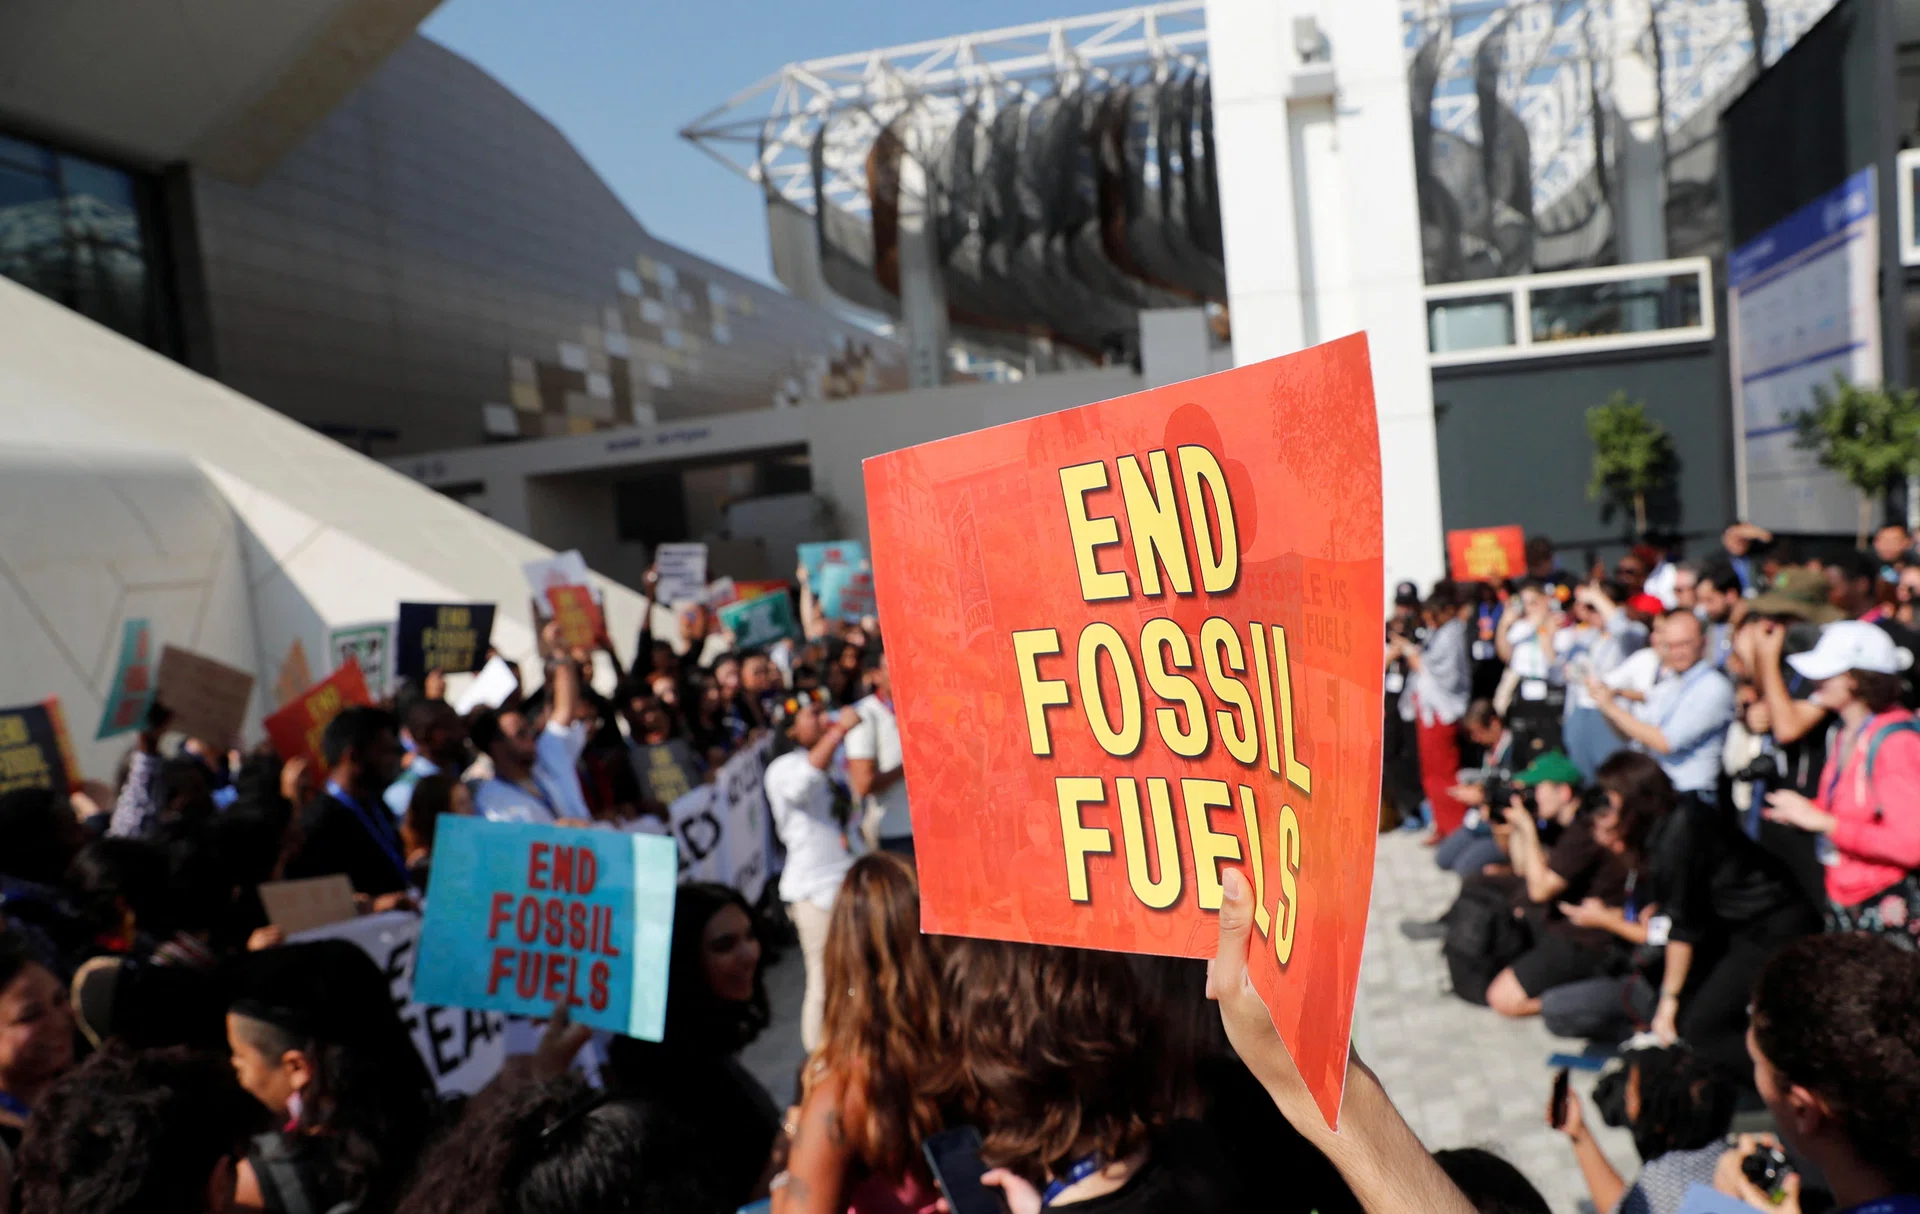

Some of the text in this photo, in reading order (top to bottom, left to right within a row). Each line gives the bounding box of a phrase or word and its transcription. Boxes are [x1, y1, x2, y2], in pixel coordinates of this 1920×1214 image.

[1058, 444, 1240, 602] END
[1305, 612, 1353, 659] FUELS
[1011, 615, 1312, 794] FOSSIL
[528, 841, 597, 896] END
[1055, 776, 1301, 966] FUELS
[487, 891, 620, 957] FOSSIL
[486, 946, 611, 1012] FUELS
